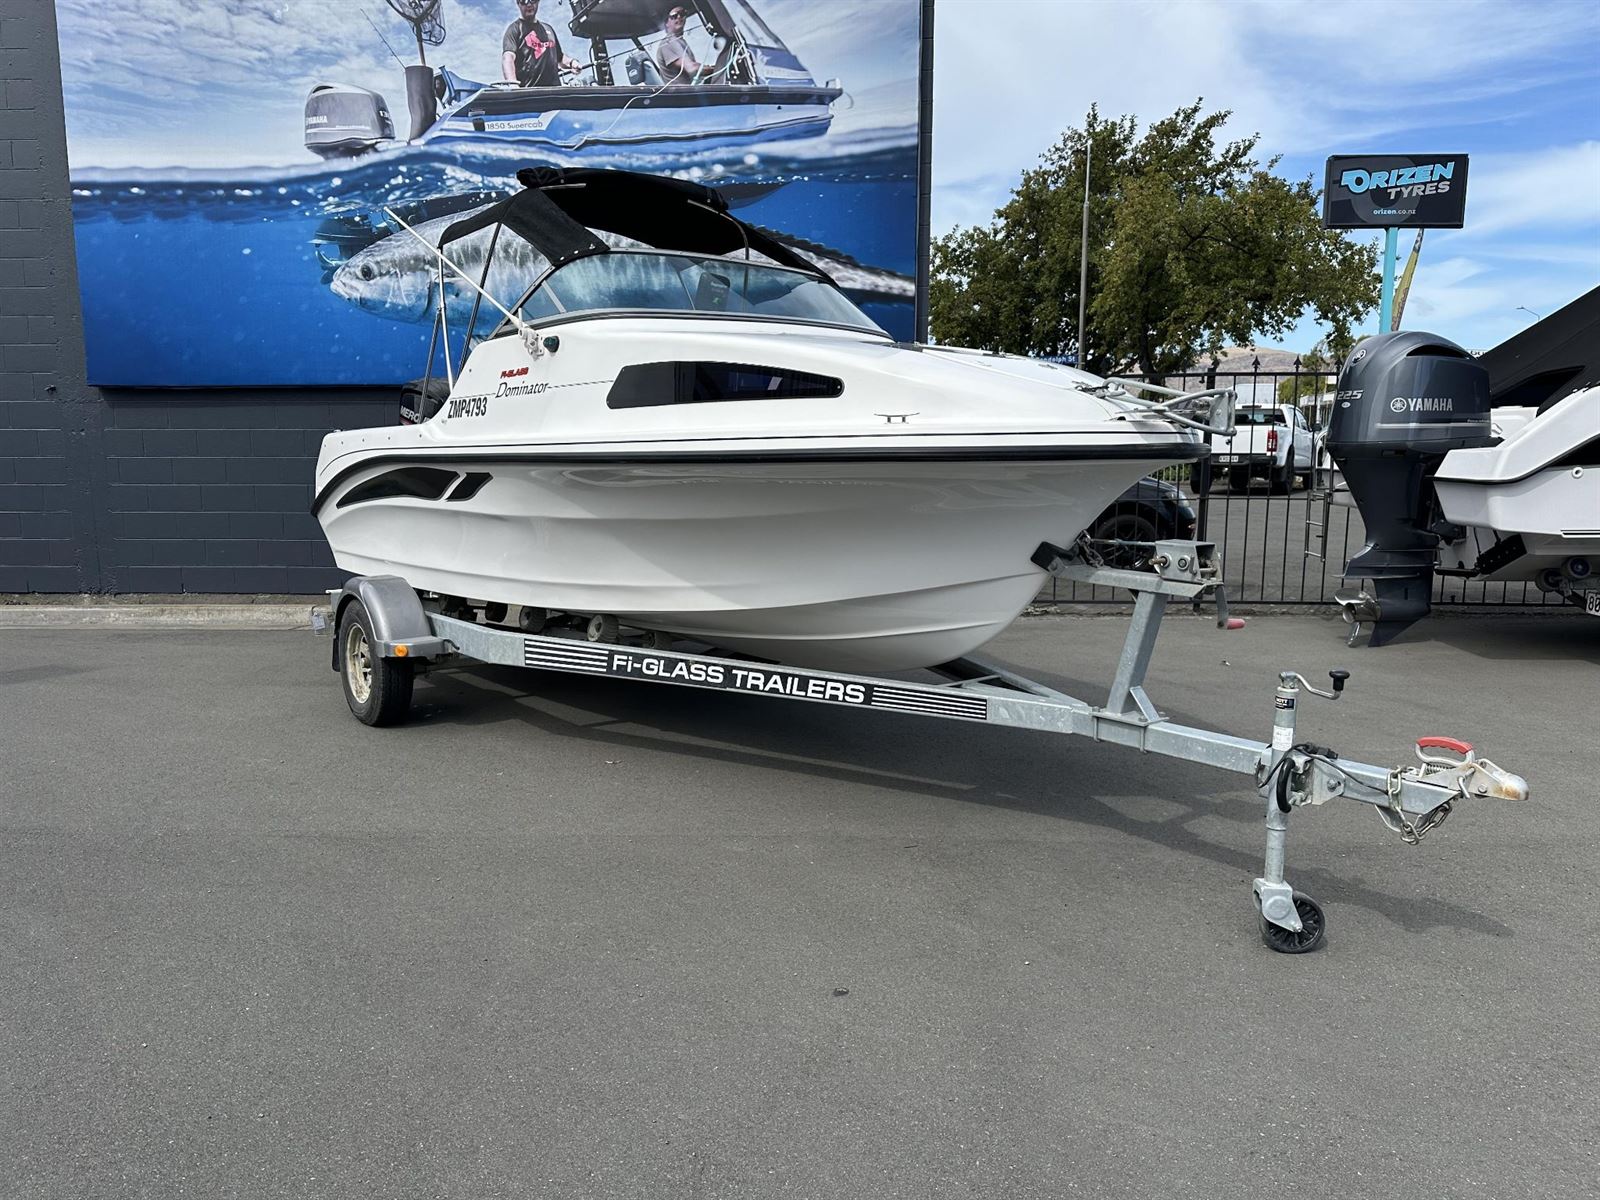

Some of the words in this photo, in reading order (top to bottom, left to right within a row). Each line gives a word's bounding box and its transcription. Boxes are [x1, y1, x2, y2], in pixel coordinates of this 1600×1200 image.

[486, 122, 505, 130] 1850
[507, 120, 543, 130] Supercab
[1341, 161, 1455, 193] ORIZEN
[1387, 181, 1451, 200] TYRES
[495, 381, 549, 398] Dominator
[1337, 390, 1364, 400] 225
[447, 396, 488, 418] ZMP4793
[1407, 398, 1453, 411] YAMAHA
[612, 654, 725, 684] Fi-GLASS
[732, 669, 866, 703] TRAILERS
